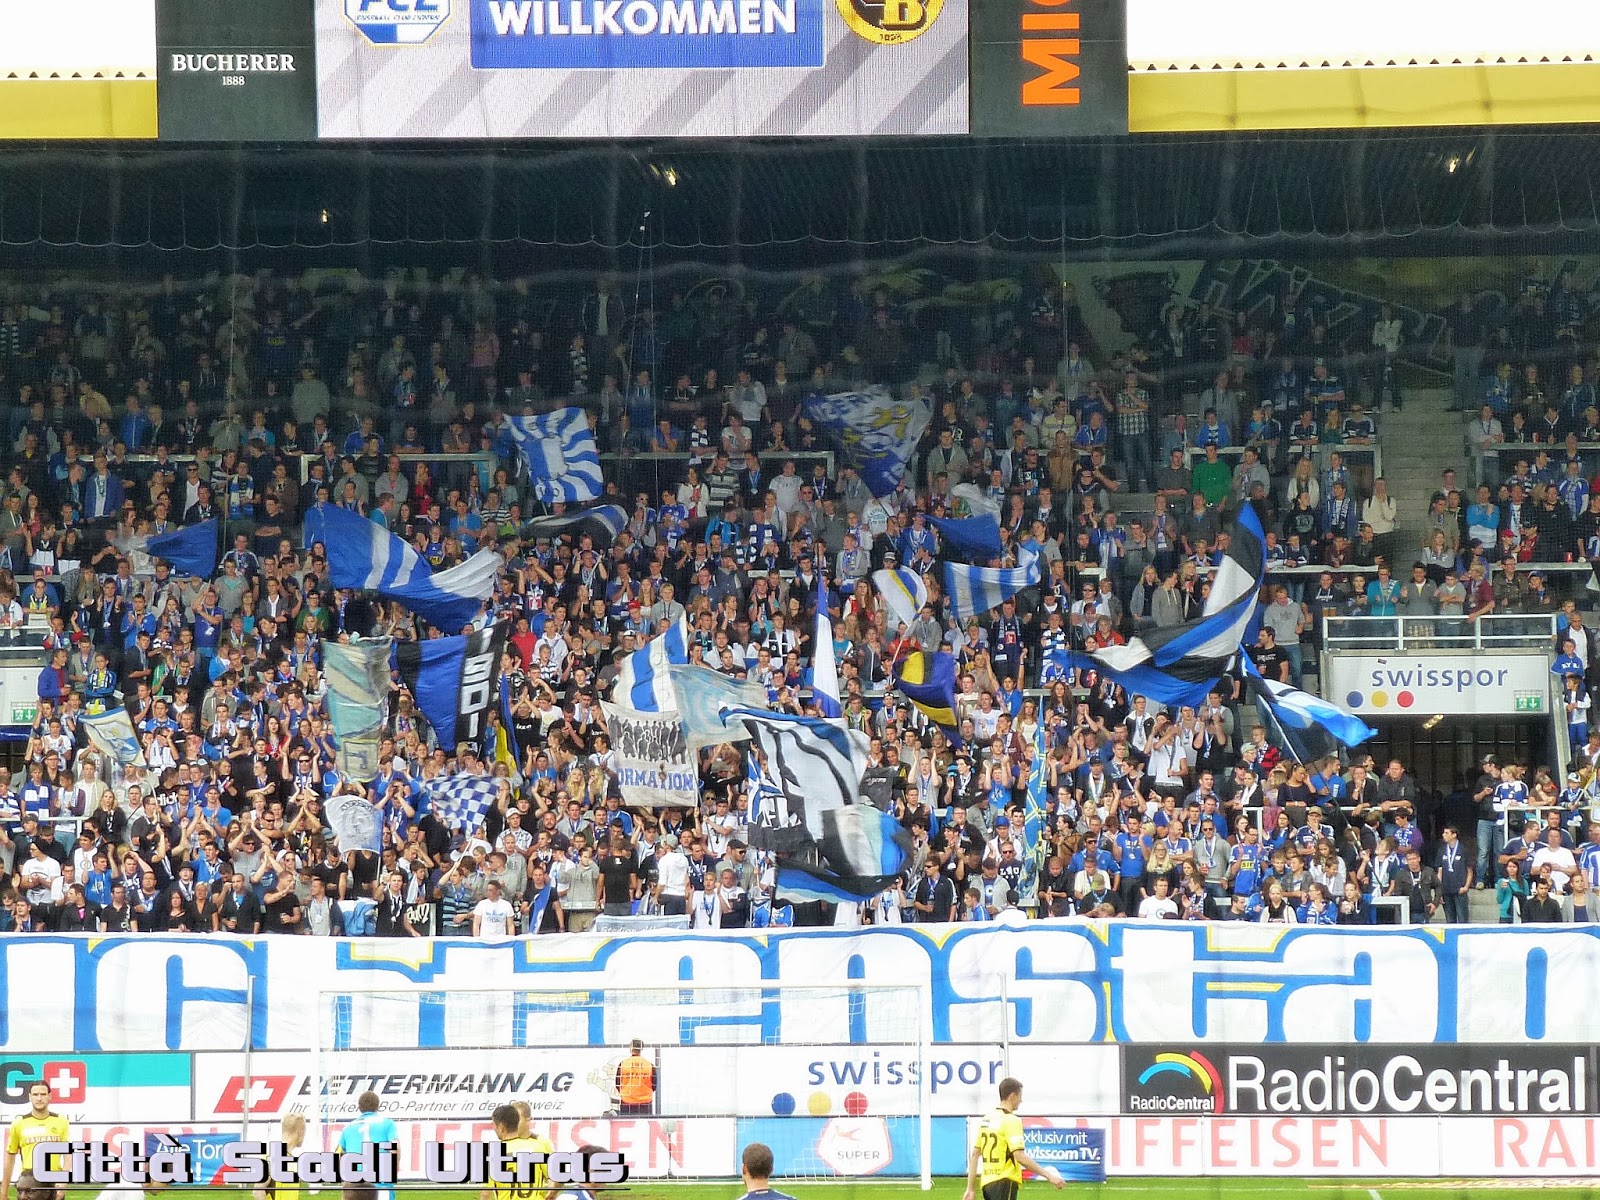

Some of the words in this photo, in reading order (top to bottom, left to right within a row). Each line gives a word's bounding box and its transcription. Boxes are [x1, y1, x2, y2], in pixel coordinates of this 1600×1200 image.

[489, 0, 797, 35] WILLKOMMEN
[172, 53, 296, 72] BUCHERER
[1022, 0, 1080, 105] MI
[222, 75, 246, 86] 1888
[1371, 663, 1508, 692] swisspor
[298, 1073, 525, 1095] BETTERMANN
[526, 1072, 574, 1093] AG
[808, 1051, 1003, 1094] swisspor
[1228, 1054, 1585, 1112] RadioCentral
[378, 1100, 459, 1113] BO-Partner
[461, 1100, 474, 1111] in
[1130, 1095, 1215, 1110] RadioCentral
[981, 1132, 999, 1163] 22
[1021, 1117, 1388, 1167] IFFEISEN
[1023, 1130, 1063, 1145] xklusiv
[1065, 1130, 1088, 1145] mit
[1494, 1117, 1595, 1167] RAI
[837, 1150, 880, 1160] SUPER
[1025, 1146, 1079, 1160] wisscom
